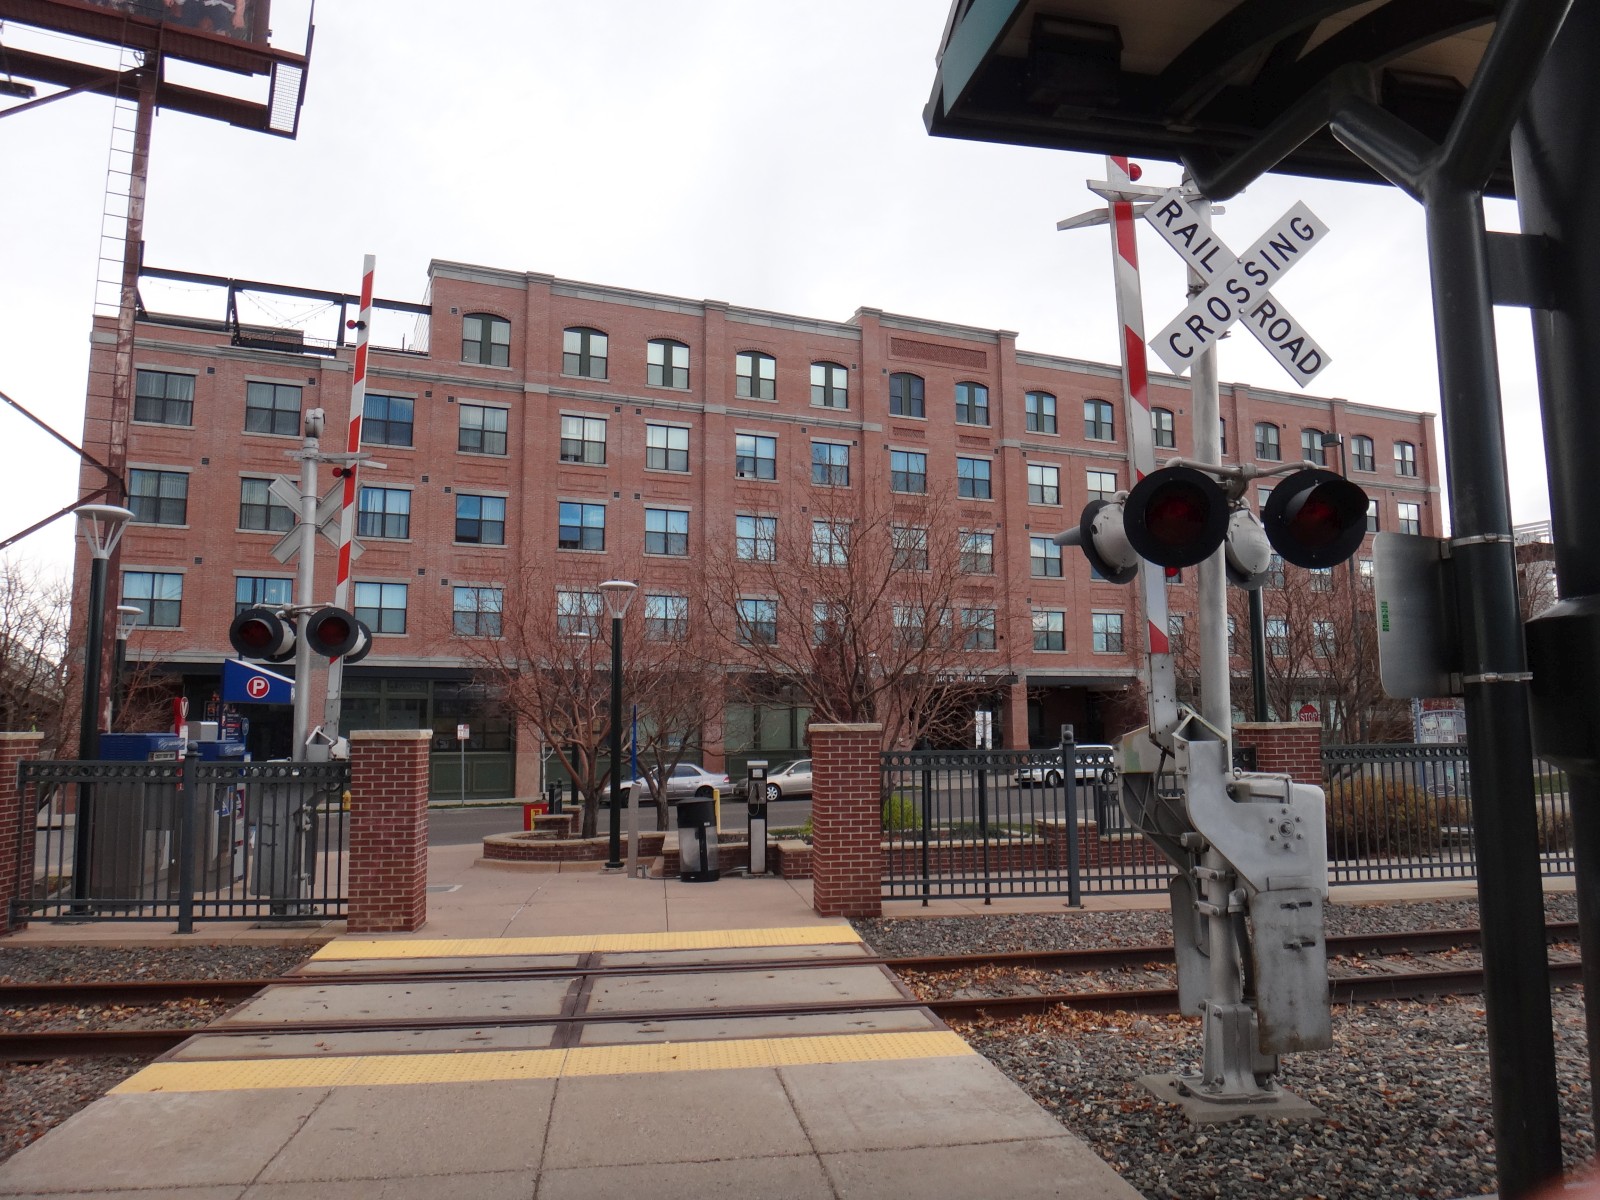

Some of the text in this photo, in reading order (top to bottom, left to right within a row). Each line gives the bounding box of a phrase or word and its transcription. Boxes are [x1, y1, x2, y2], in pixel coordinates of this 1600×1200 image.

[1156, 199, 1322, 375] RAIL ROAD
[1169, 217, 1315, 359] CROSSING
[252, 679, 266, 695] P
[1300, 712, 1318, 722] STOP
